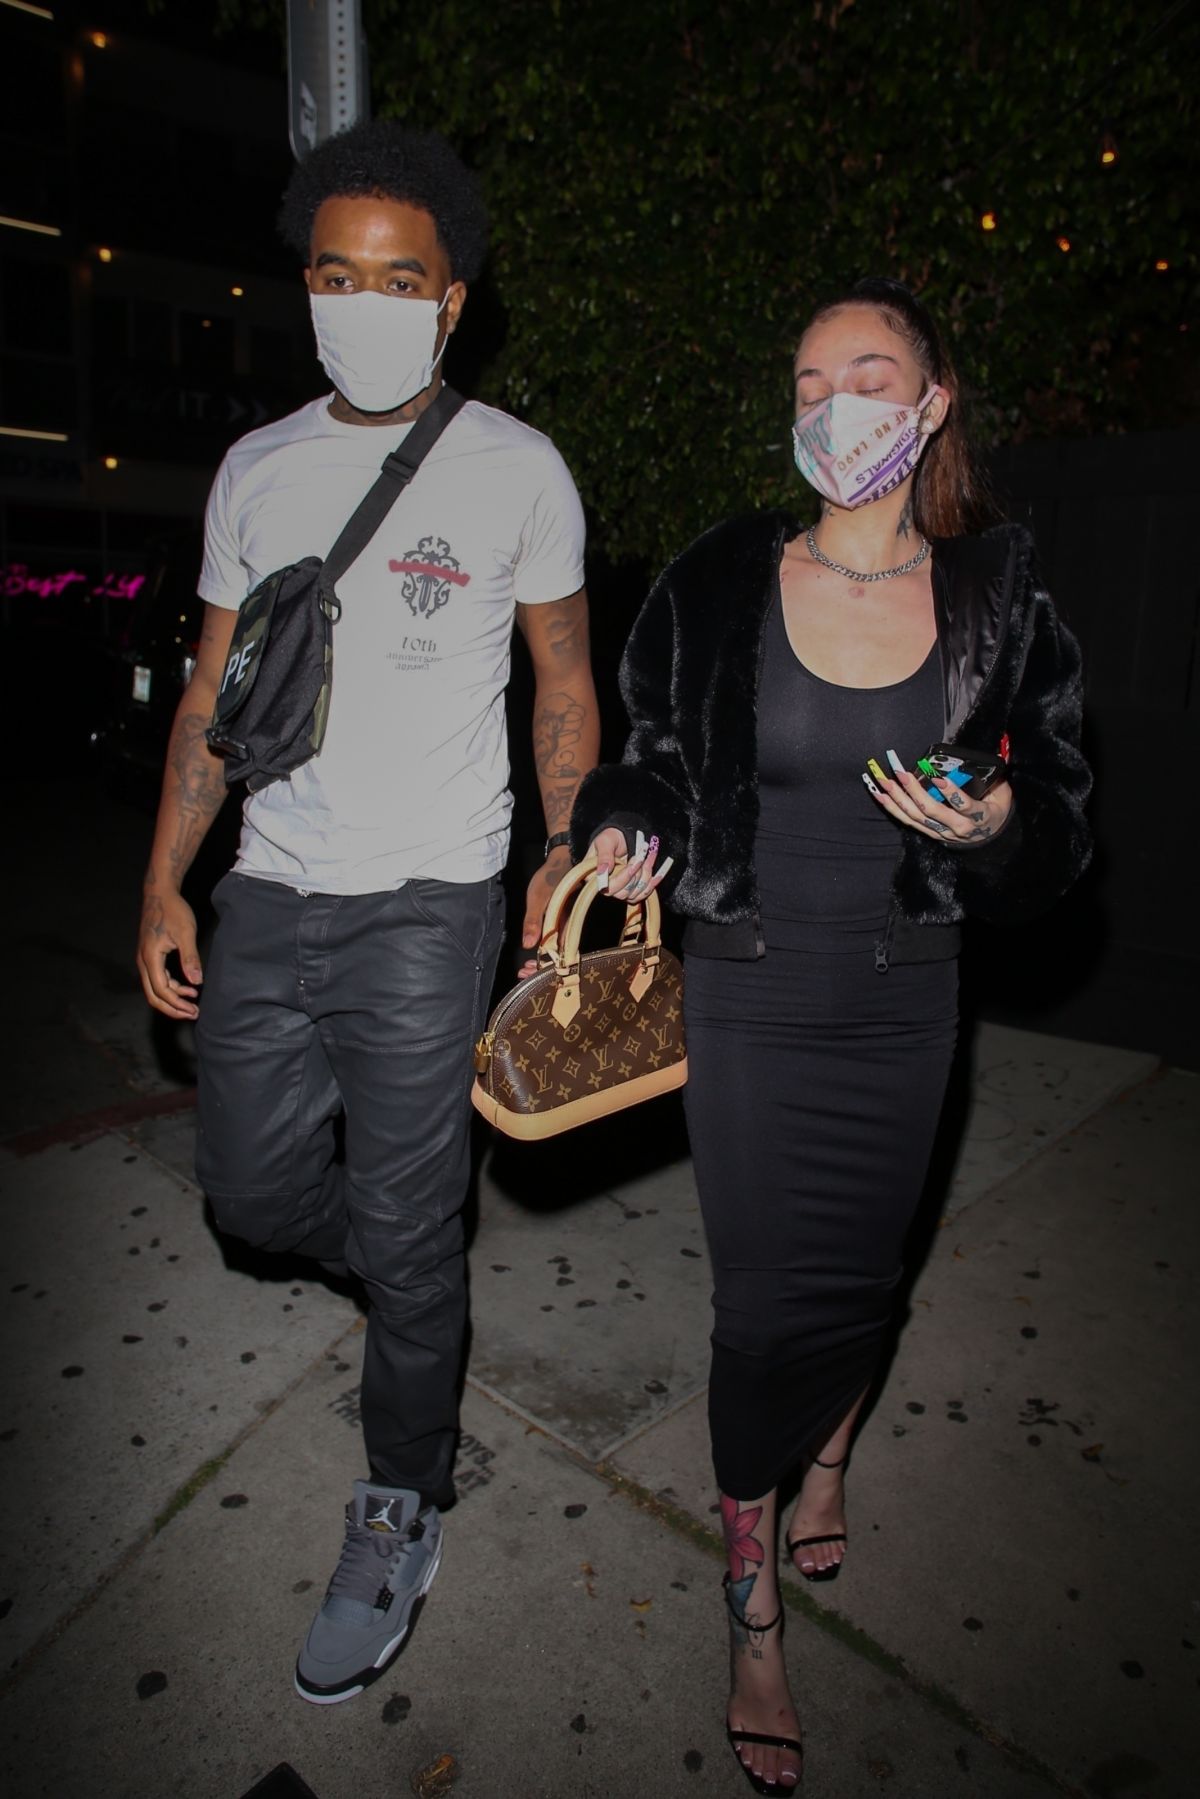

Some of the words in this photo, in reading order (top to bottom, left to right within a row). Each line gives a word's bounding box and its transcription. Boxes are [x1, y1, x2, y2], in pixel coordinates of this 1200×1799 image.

[218, 640, 255, 700] PE
[599, 977, 617, 1002] LV
[529, 992, 551, 1019] LV
[651, 1024, 673, 1050] LV
[591, 1044, 614, 1071] LV
[532, 1065, 553, 1093] LV
